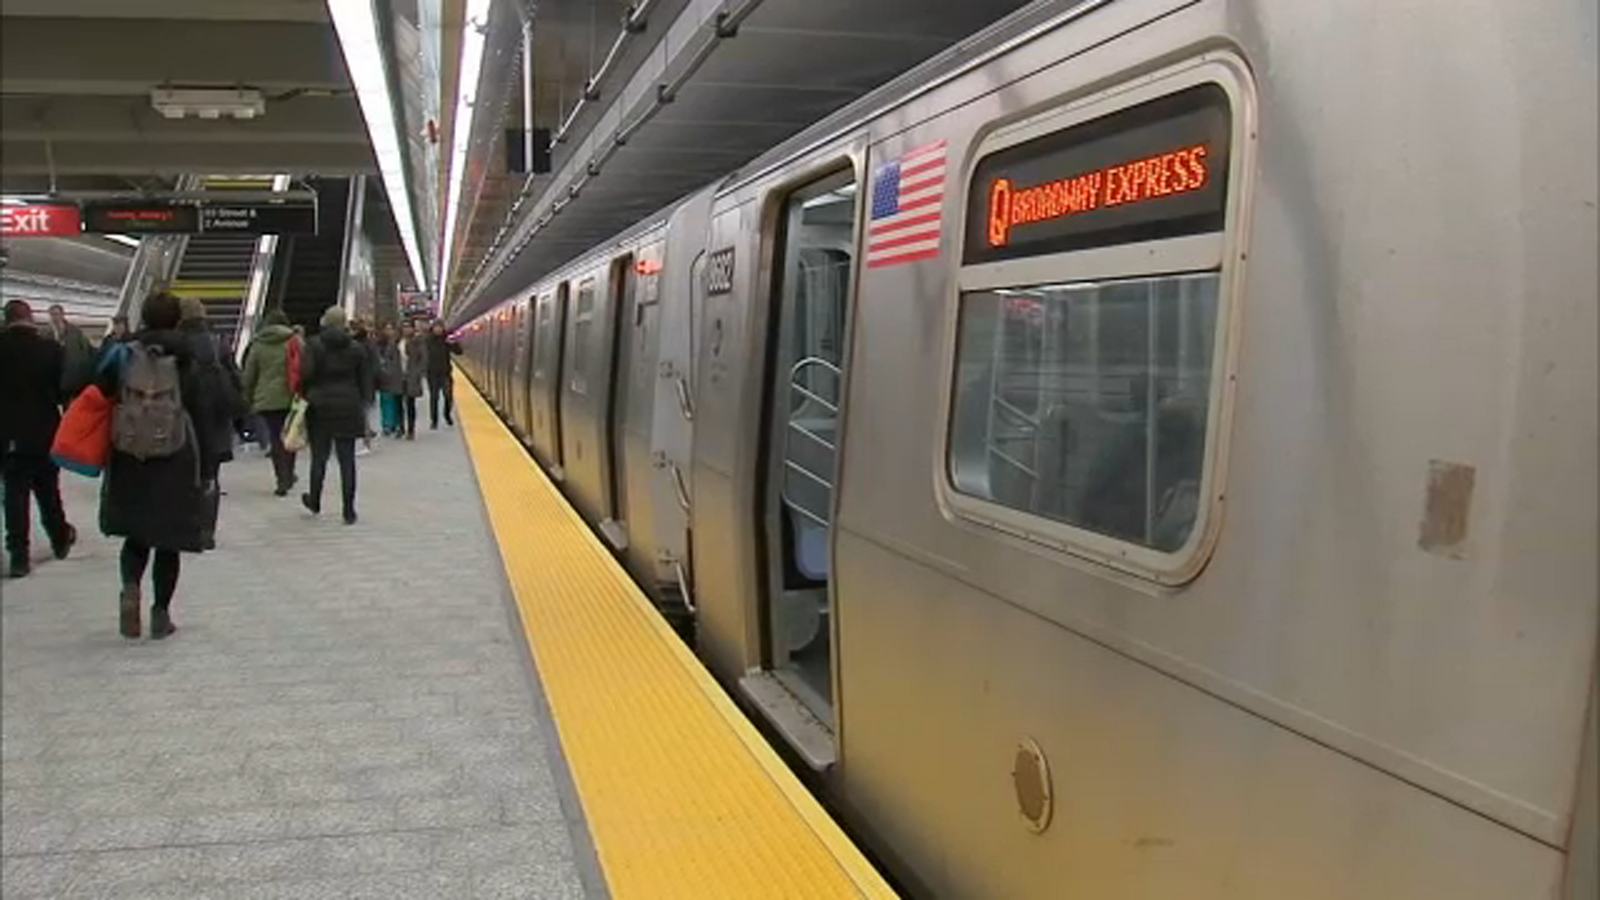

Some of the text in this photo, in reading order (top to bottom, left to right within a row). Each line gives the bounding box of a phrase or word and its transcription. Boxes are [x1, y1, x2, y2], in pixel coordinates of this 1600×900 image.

[1, 208, 51, 232] Exit
[988, 145, 1207, 247] Q BROADWAY EXPRESS
